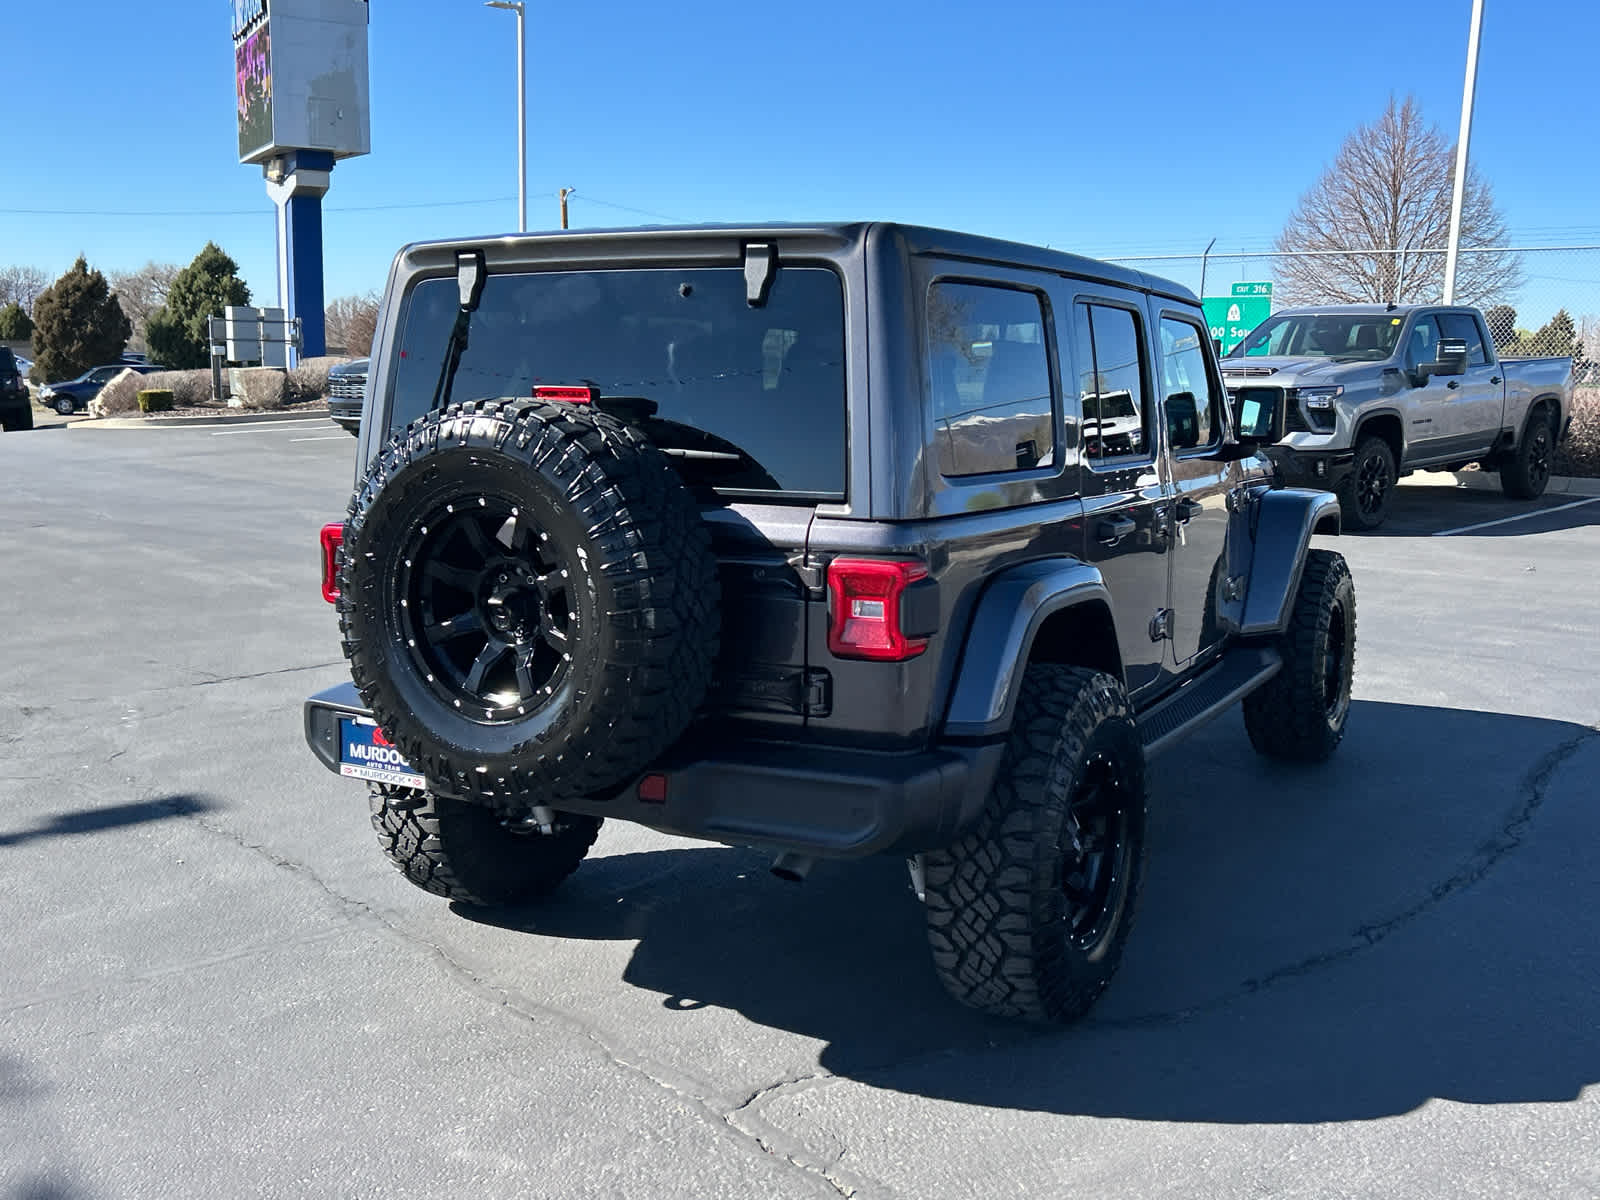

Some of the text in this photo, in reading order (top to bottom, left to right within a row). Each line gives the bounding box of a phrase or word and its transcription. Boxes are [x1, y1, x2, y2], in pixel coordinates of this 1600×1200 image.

[1253, 284, 1267, 294] 316
[1209, 326, 1251, 338] 00 Sou
[350, 743, 409, 766] MURDOC
[360, 769, 406, 783] MURDOCK
